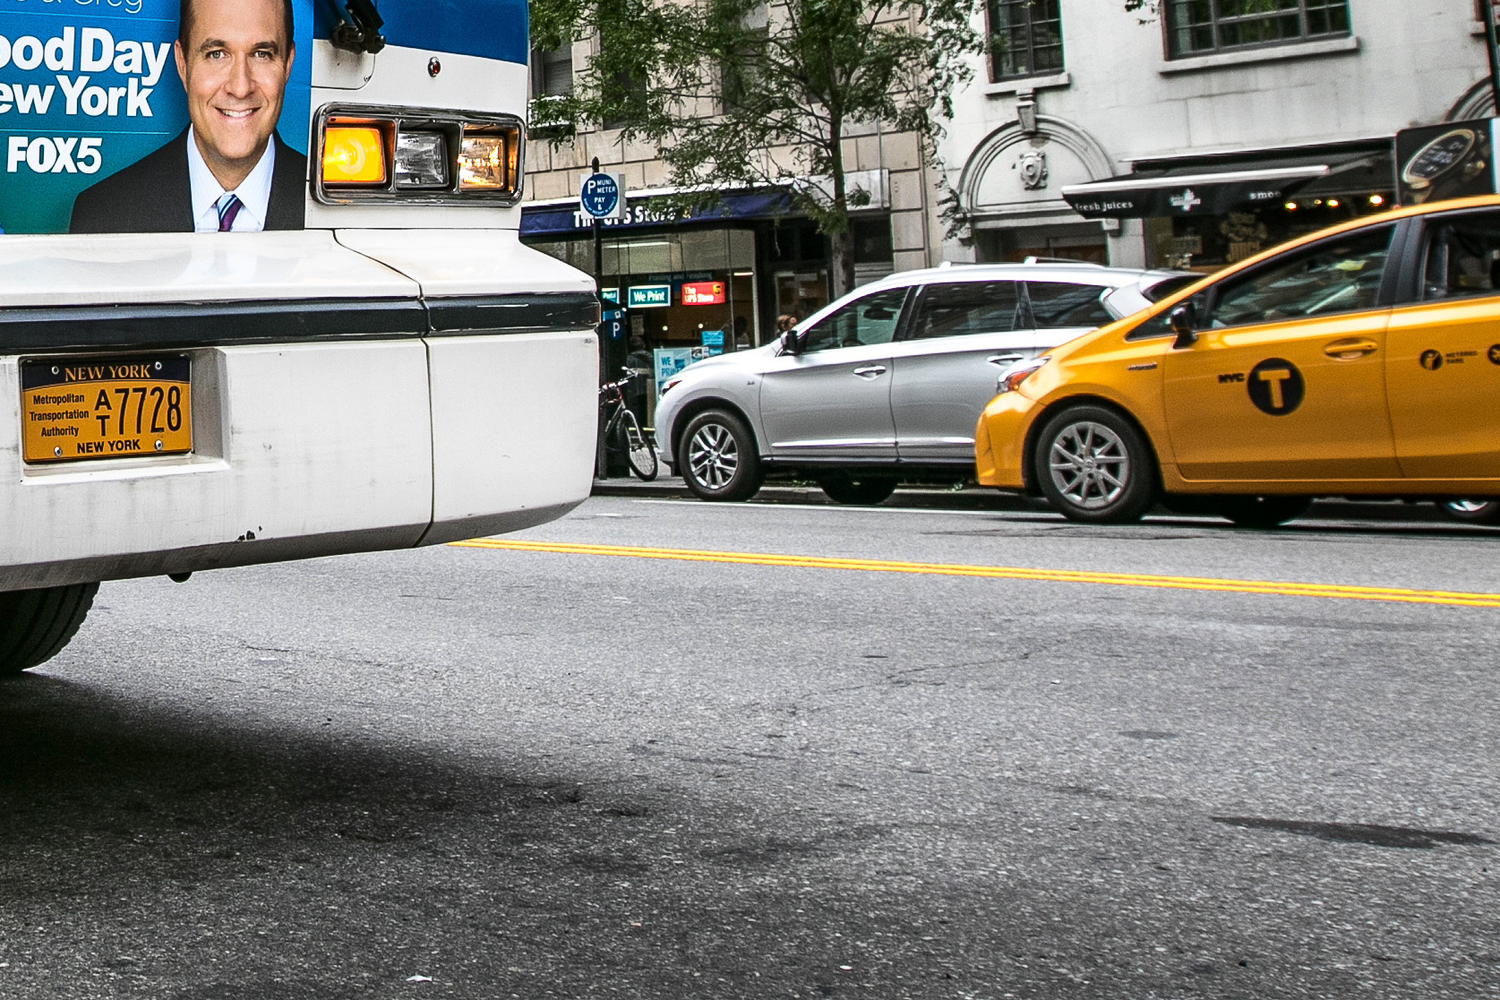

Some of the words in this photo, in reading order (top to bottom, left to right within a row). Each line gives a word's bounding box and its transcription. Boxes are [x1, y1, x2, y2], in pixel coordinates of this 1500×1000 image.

[79, 27, 171, 86] Day
[56, 75, 153, 117] York
[588, 180, 596, 194] P
[597, 186, 616, 194] METER
[1102, 200, 1134, 212] juices
[633, 291, 647, 302] We
[647, 290, 666, 301] Print
[65, 367, 104, 381] NEW
[109, 365, 150, 379] YORK
[1218, 373, 1245, 384] NYC
[1259, 369, 1291, 408] T
[33, 394, 85, 405] Metropolitan
[29, 409, 89, 422] Transportation
[41, 425, 79, 438] Authority
[77, 441, 104, 454] NEW
[109, 439, 141, 451] YORK
